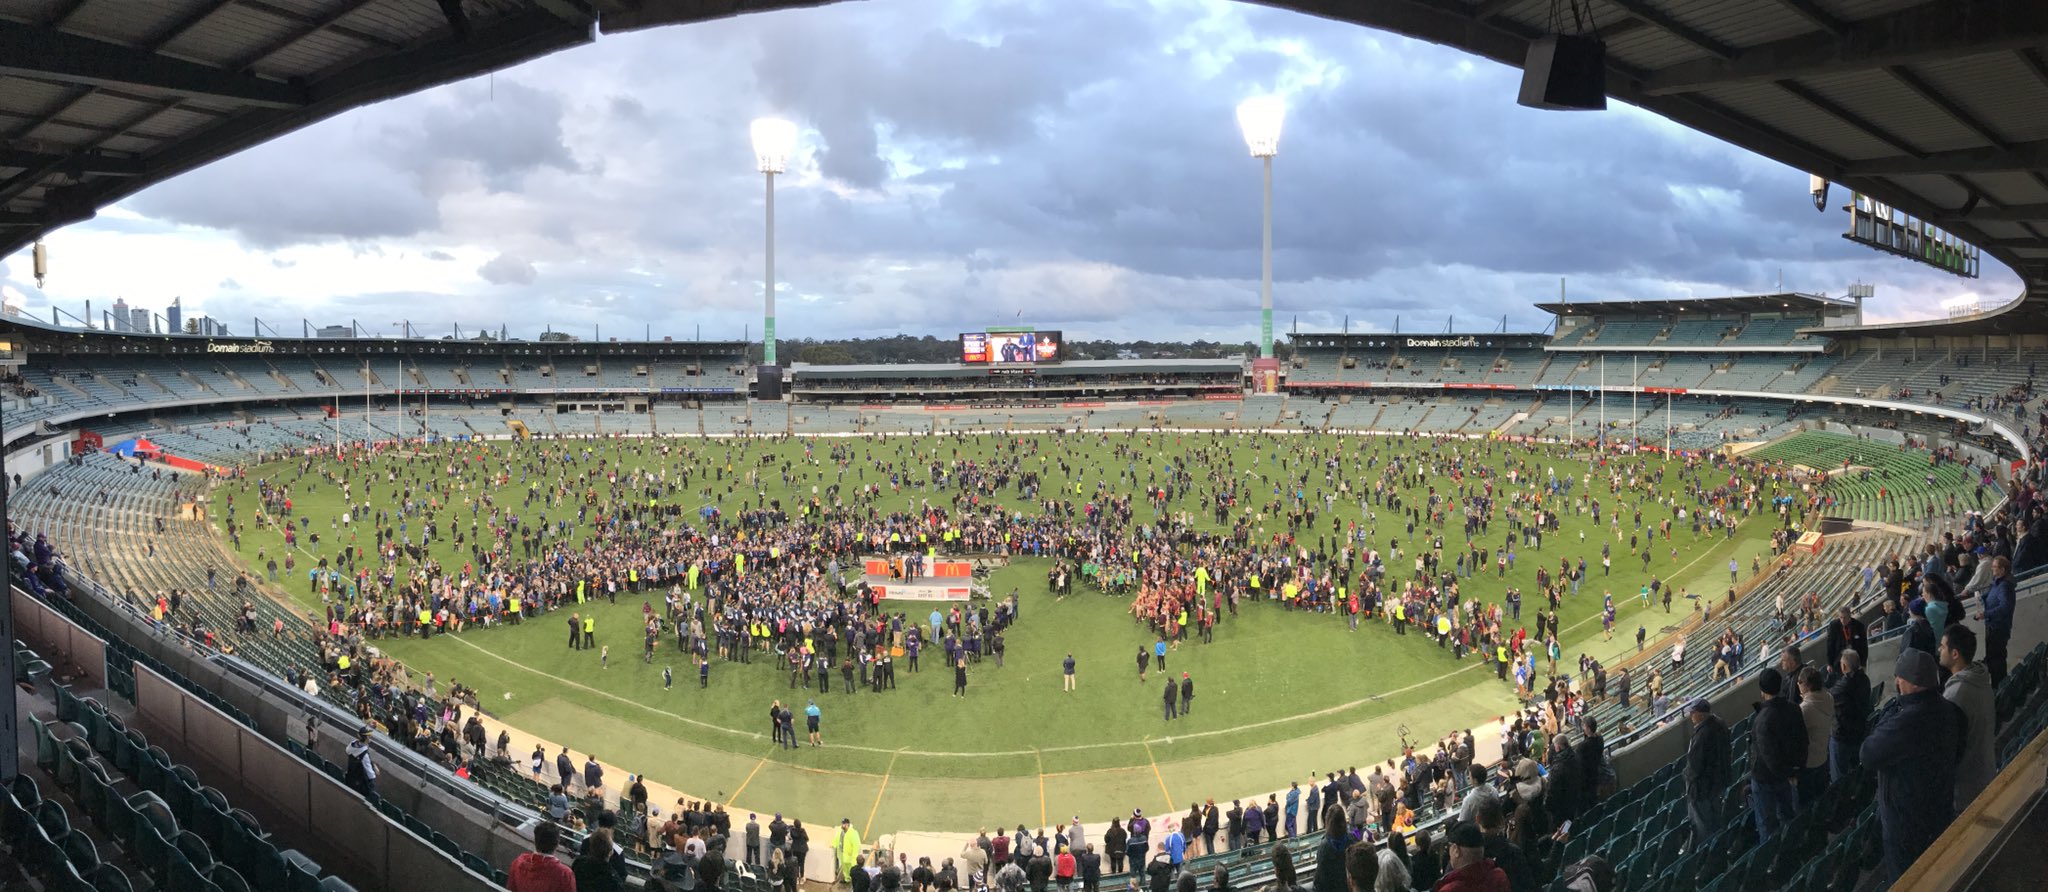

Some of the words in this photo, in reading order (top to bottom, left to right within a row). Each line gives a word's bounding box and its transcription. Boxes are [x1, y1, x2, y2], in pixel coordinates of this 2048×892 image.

[1407, 338, 1441, 347] Domain
[1442, 336, 1475, 347] stadium
[207, 343, 240, 353] Domain
[241, 342, 272, 353] stadium
